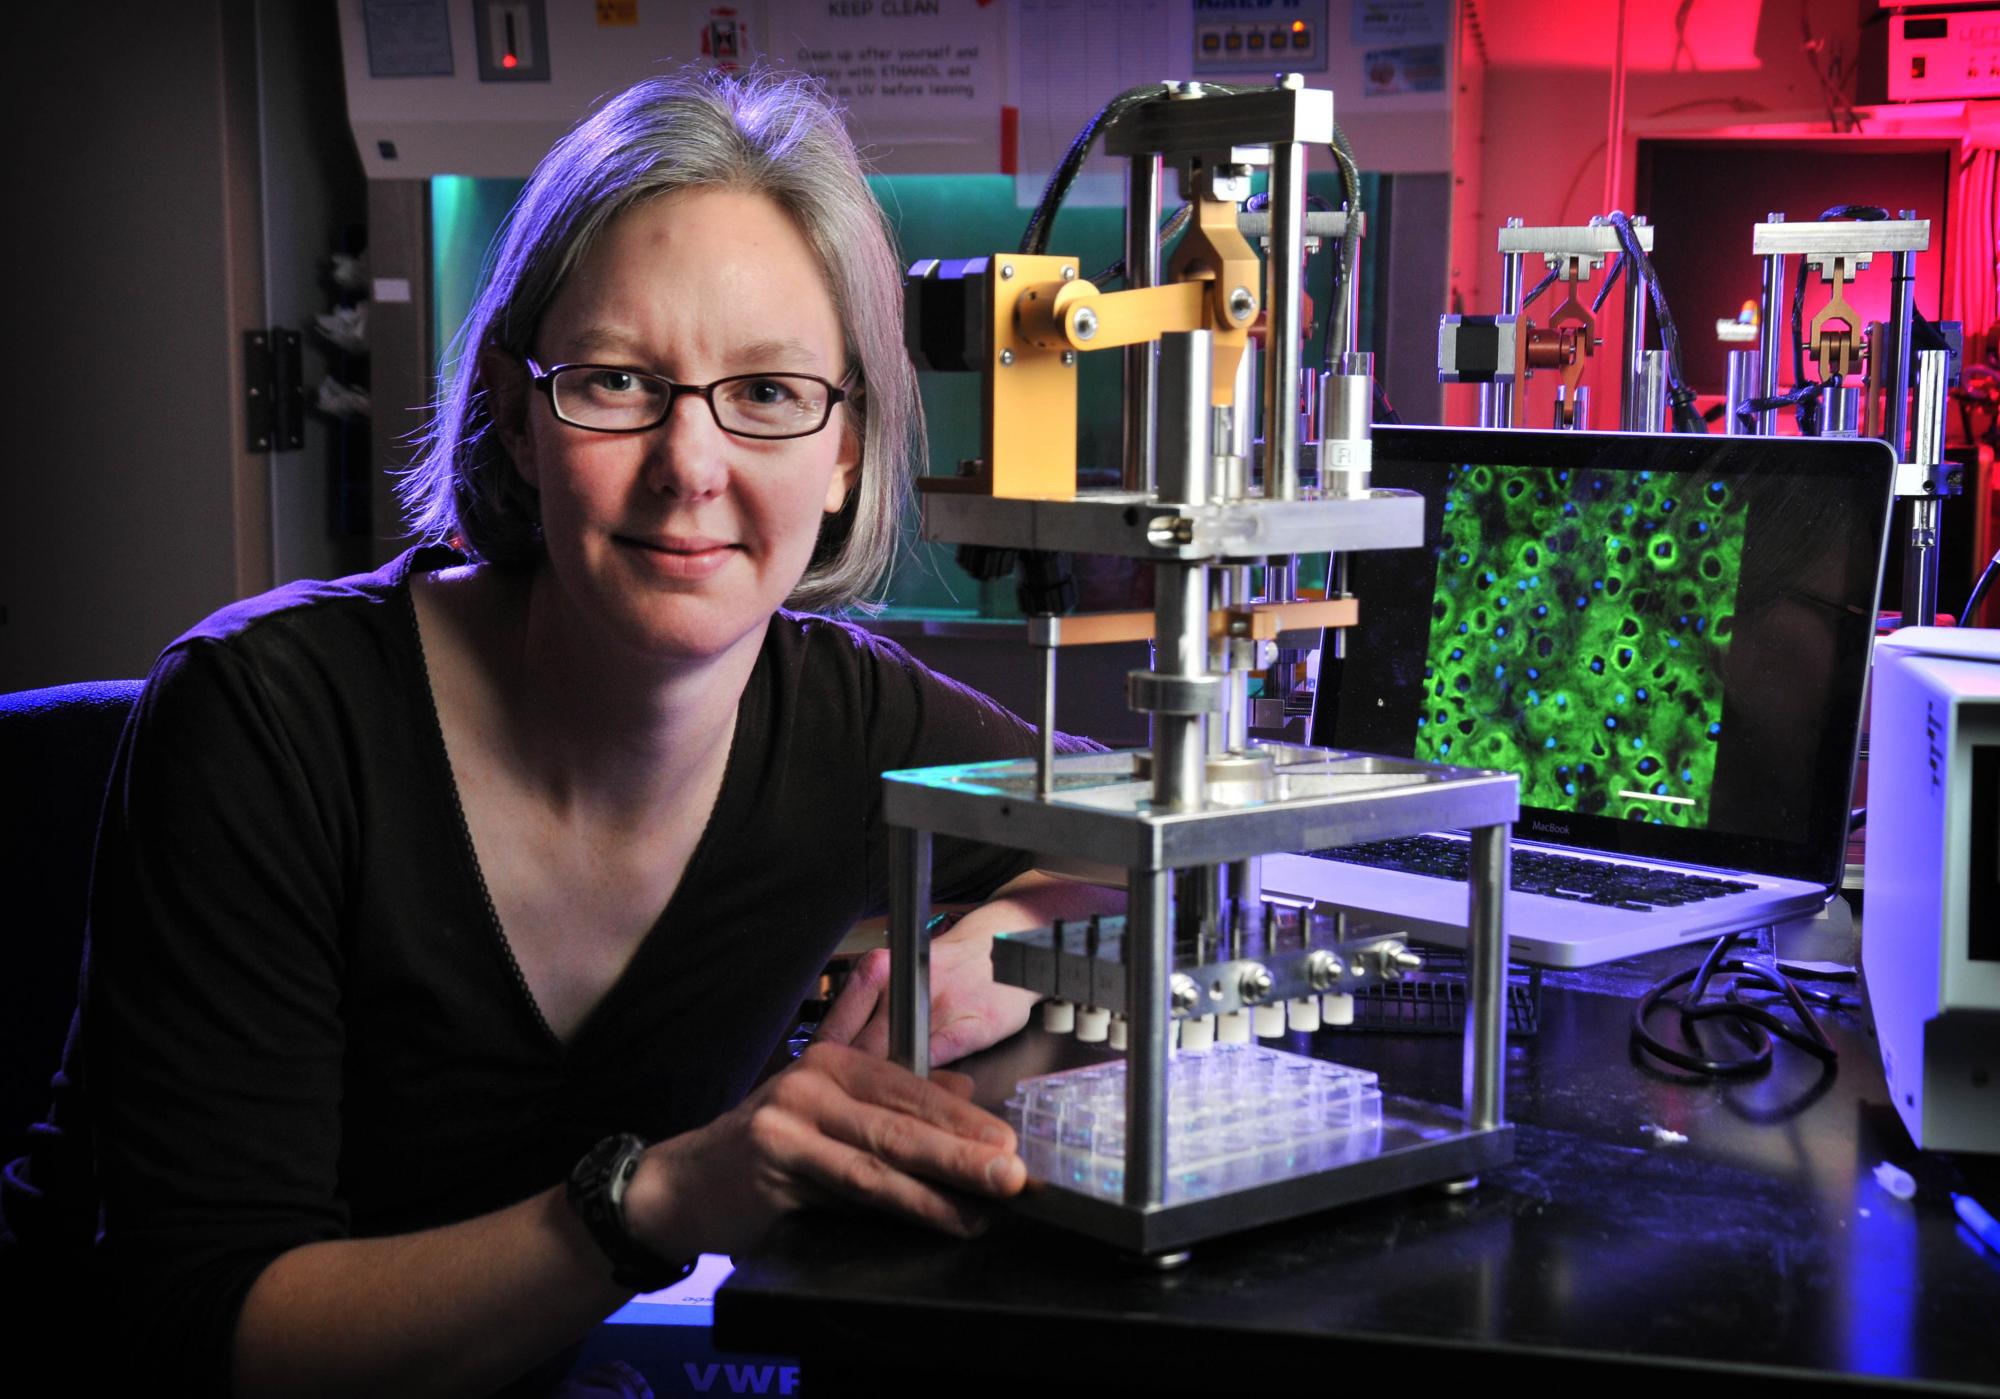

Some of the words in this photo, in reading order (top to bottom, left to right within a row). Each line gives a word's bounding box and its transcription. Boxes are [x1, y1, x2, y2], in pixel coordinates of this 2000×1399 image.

[829, 0, 873, 17] KEEP
[881, 0, 939, 16] CLEAN
[837, 49, 852, 62] up
[858, 46, 892, 60] after
[899, 45, 951, 61] yourself
[956, 45, 979, 59] and
[848, 64, 875, 78] with
[881, 64, 940, 78] ETHANOL
[948, 65, 970, 77] and
[857, 84, 874, 96] UV
[881, 83, 923, 97] before
[930, 84, 974, 98] leaving
[1532, 821, 1570, 835] MacBook
